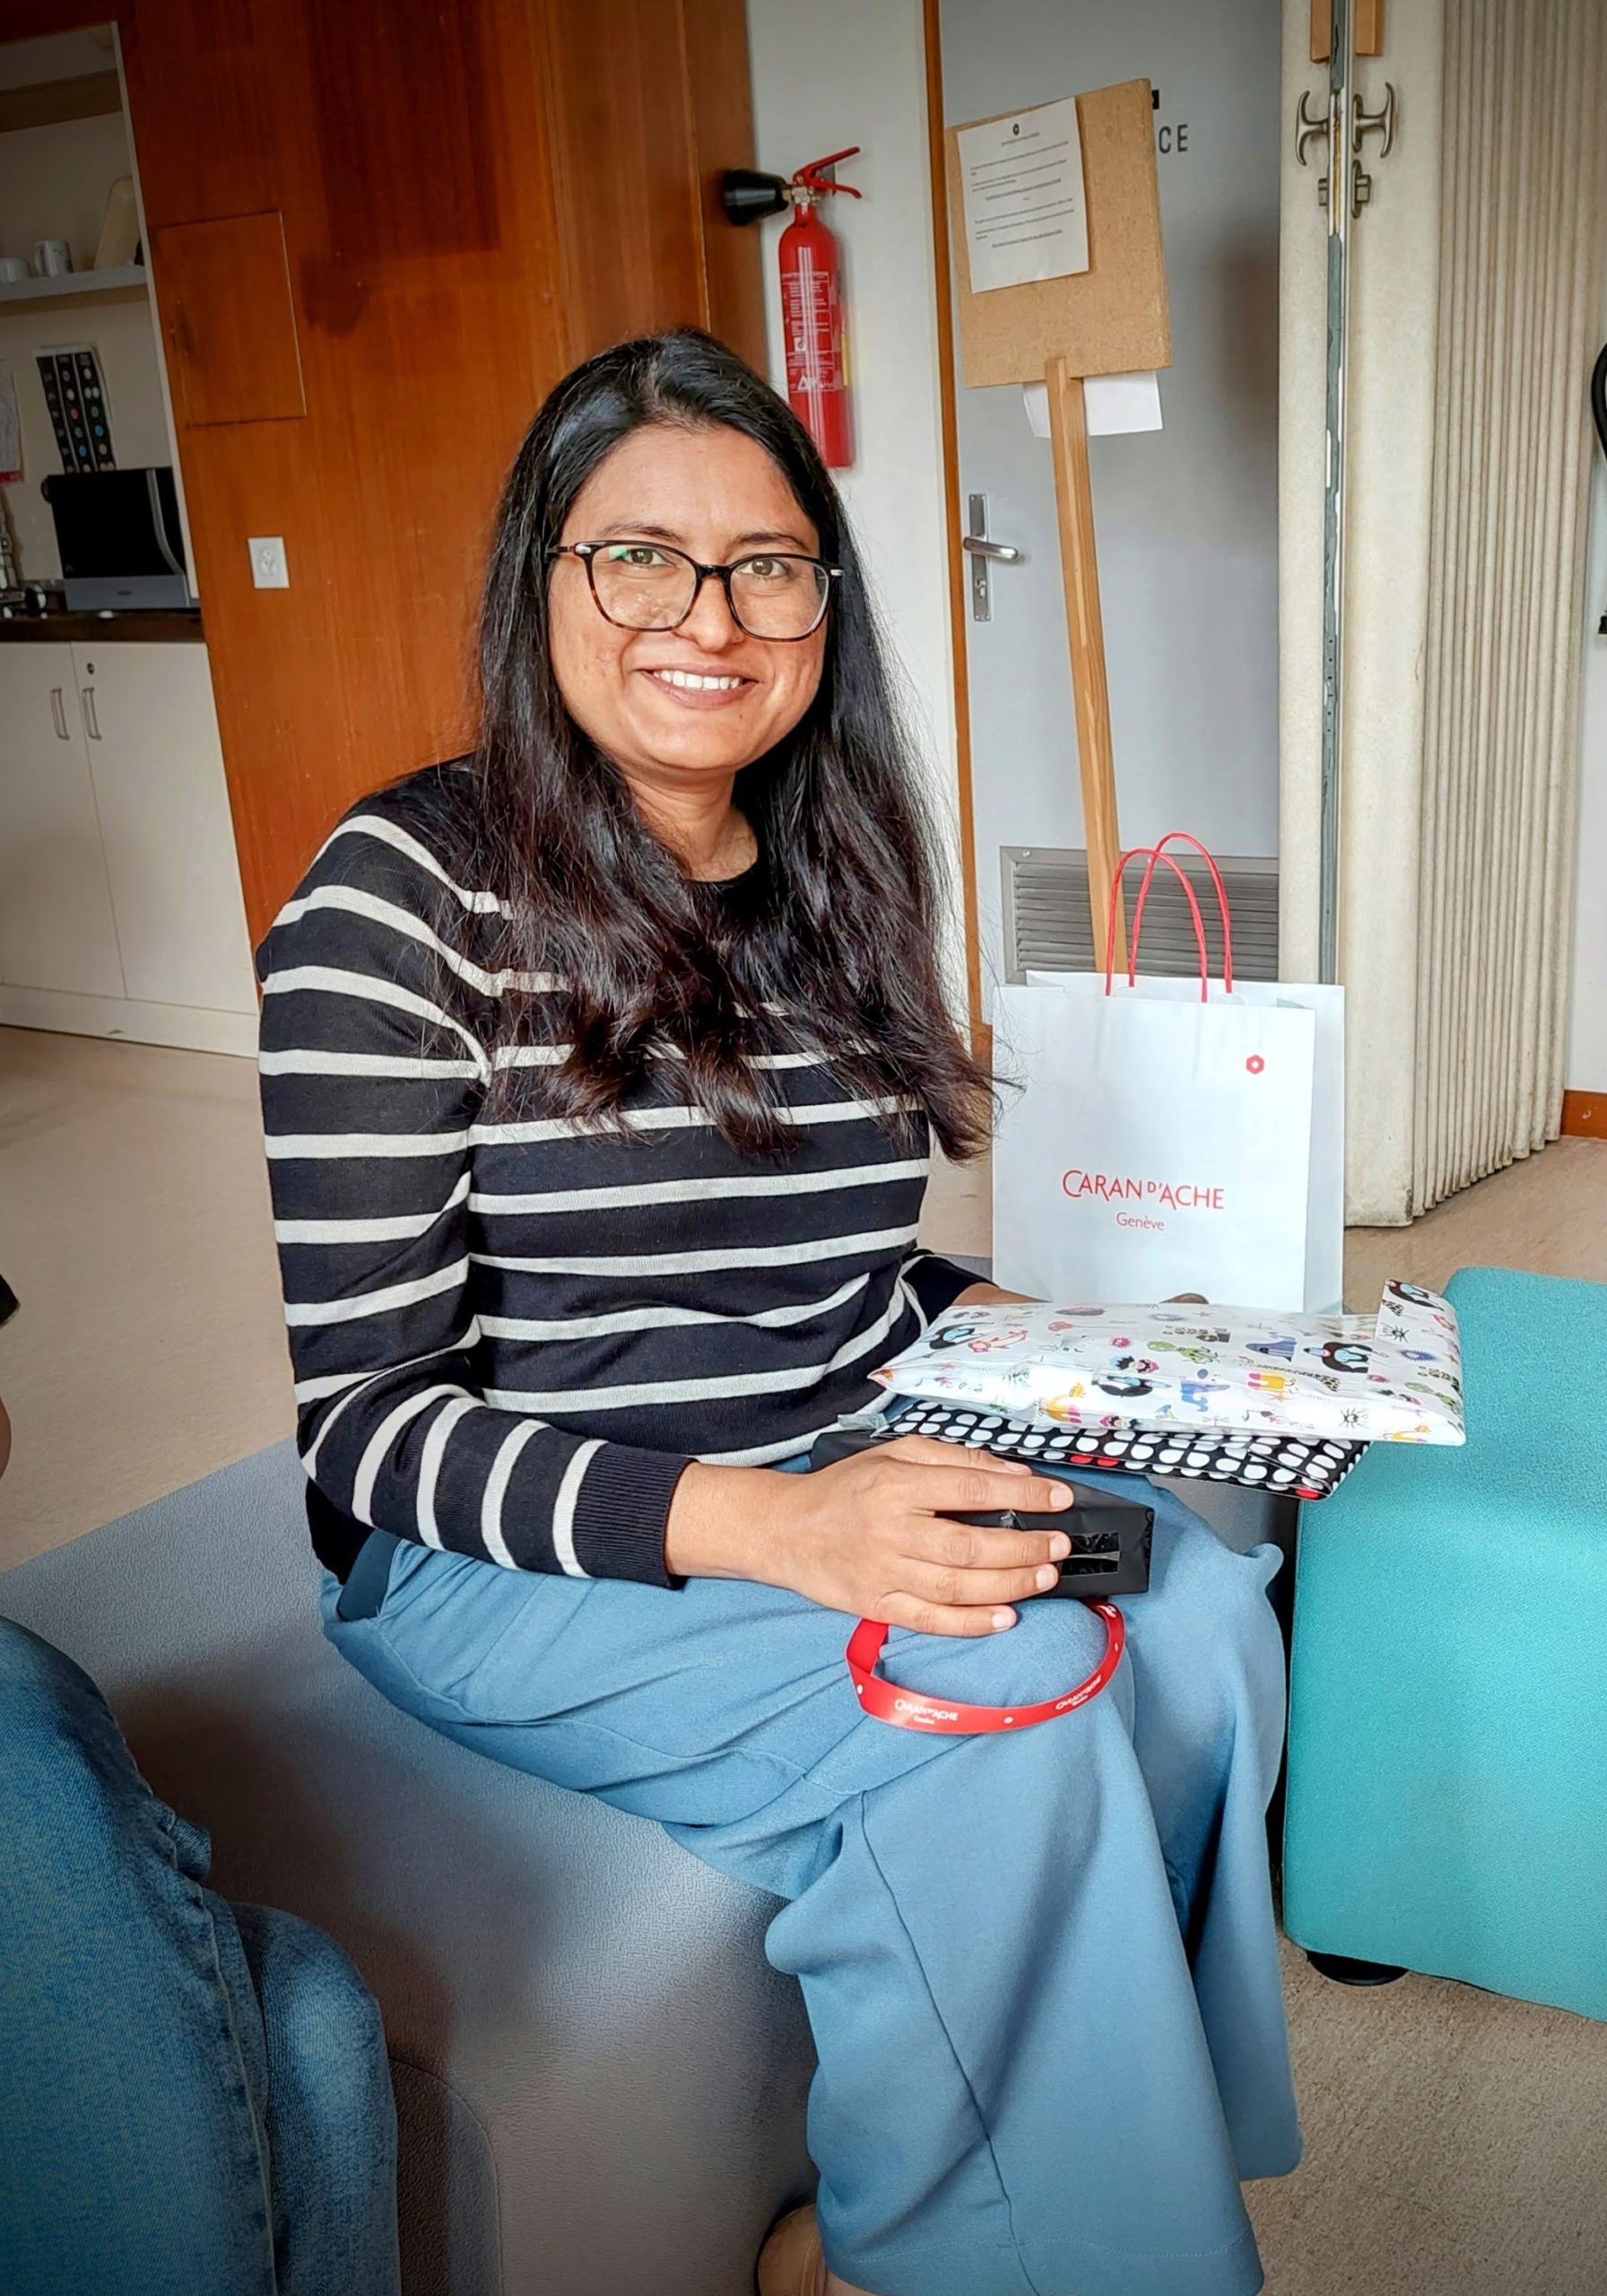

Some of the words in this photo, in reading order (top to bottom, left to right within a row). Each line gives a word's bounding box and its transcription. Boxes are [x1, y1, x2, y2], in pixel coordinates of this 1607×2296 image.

[1159, 124, 1188, 154] CE
[1062, 1170, 1142, 1202] CARAN
[1147, 1181, 1225, 1211] D'ACHE
[1116, 1212, 1165, 1231] Genève
